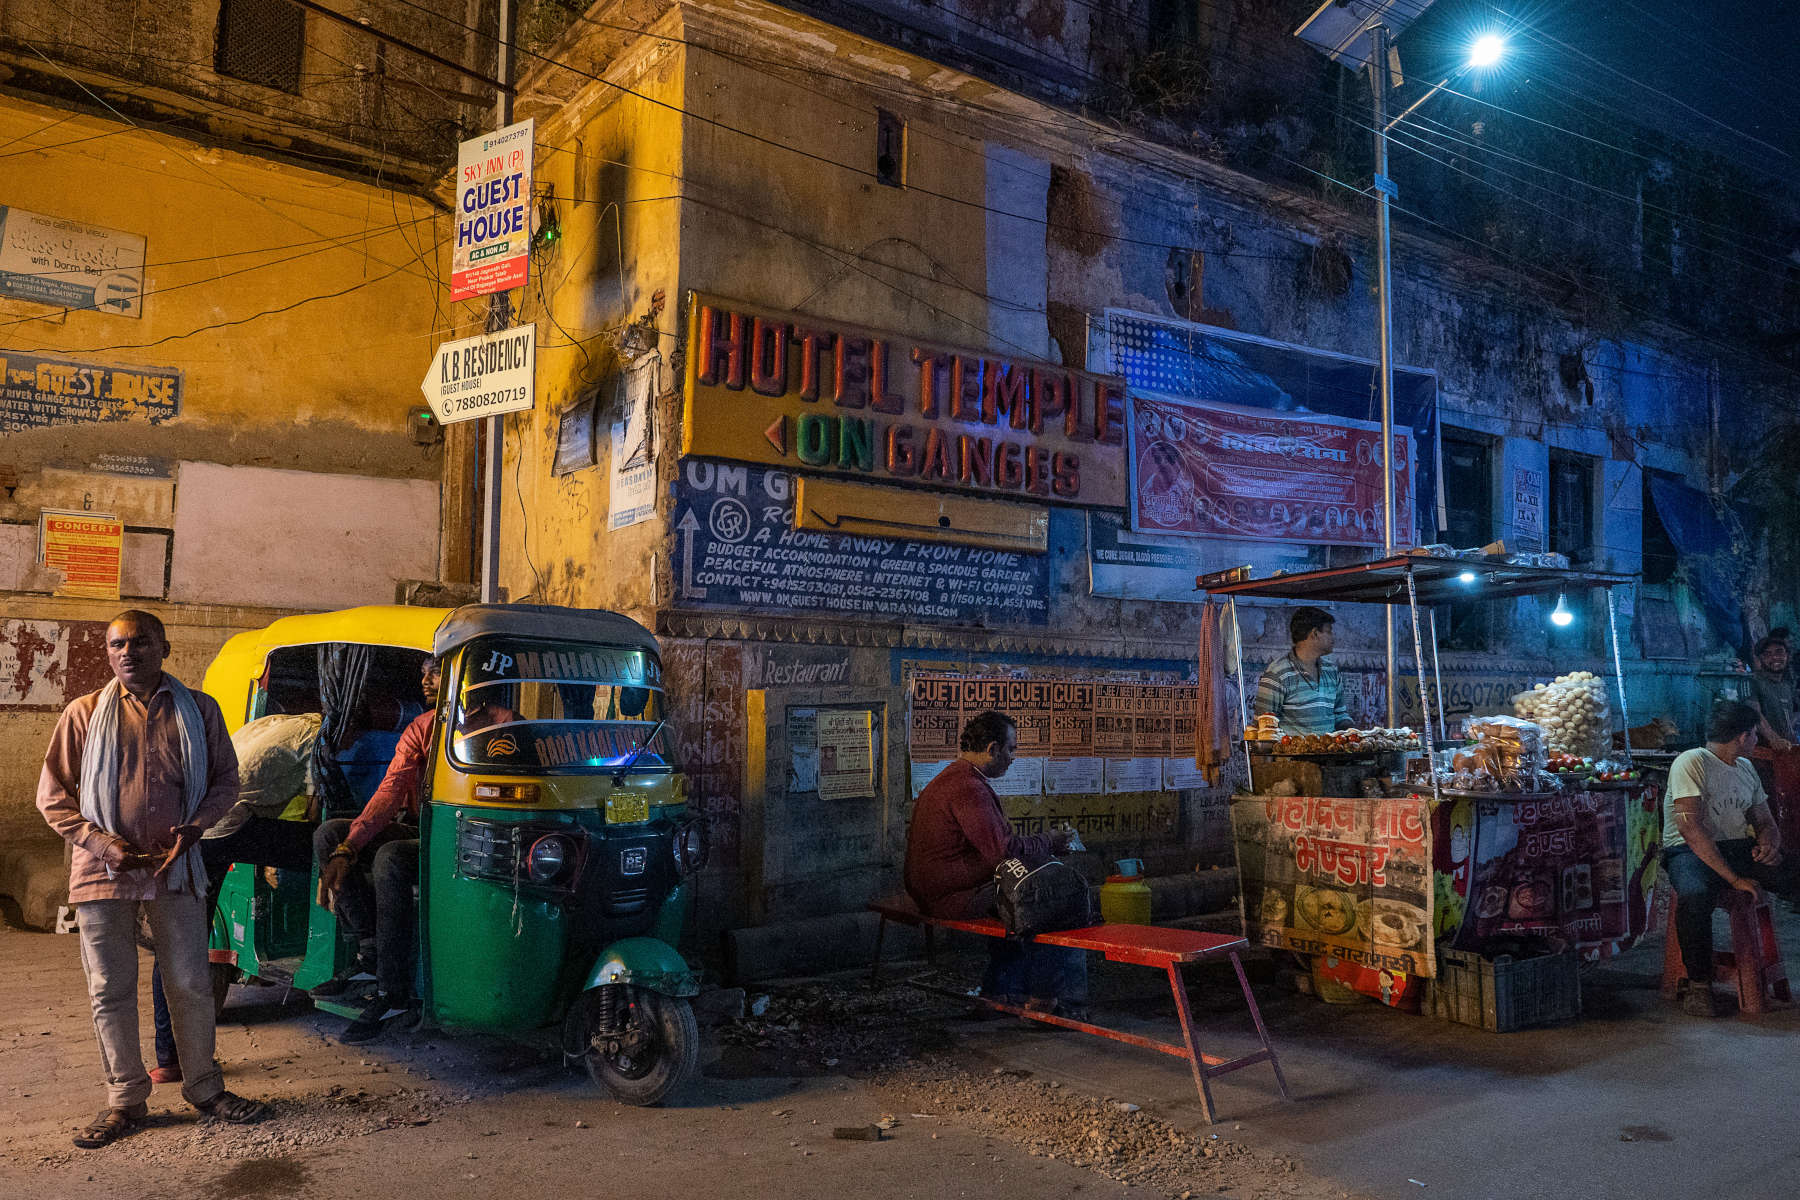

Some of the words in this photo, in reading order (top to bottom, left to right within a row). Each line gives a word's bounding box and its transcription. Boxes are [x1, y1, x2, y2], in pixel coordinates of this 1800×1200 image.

[464, 162, 483, 183] SKY
[486, 154, 504, 176] INN
[508, 148, 524, 169] (P)
[463, 172, 523, 214] GUEST
[458, 204, 524, 248] HOUSE
[31, 255, 50, 267] with
[54, 258, 81, 271] Dorm
[486, 246, 499, 256] NON
[464, 334, 529, 379] RESIDENCY
[441, 382, 460, 396] (GUEST
[461, 377, 482, 393] HOUSE)
[455, 386, 526, 412] 7880820719
[910, 346, 1126, 447] TEMPLE
[32, 403, 57, 414] WITH
[796, 413, 875, 473] ON
[884, 423, 1081, 498] GANGES
[687, 461, 747, 496] OM
[55, 521, 115, 533] CONCERT
[753, 527, 771, 543] A
[779, 530, 830, 549] HOME
[839, 537, 895, 555] AWAY
[904, 542, 961, 561] FROM
[967, 550, 1022, 567] HOME
[707, 542, 762, 558] BUDGET
[764, 549, 870, 568] ACCOMMODATION
[880, 558, 919, 572] GREEN
[928, 562, 978, 577] SPACIOUS
[981, 569, 1031, 582] GARDEN
[696, 572, 761, 588] CONTACT
[703, 556, 778, 575] PEACEFUL
[781, 563, 863, 582] ATMOSPHERE
[873, 571, 932, 588] INTERNET
[949, 577, 981, 592] WI-FI
[983, 583, 1034, 596] CAMPUS
[482, 651, 513, 676] JP
[765, 657, 849, 684] Restaurant
[914, 680, 959, 702] CUET
[964, 682, 1006, 702] CUET
[1009, 683, 1051, 702] CUET
[1053, 684, 1092, 703] CUET
[912, 715, 938, 729] CHS
[1053, 717, 1075, 729] CHS
[1296, 835, 1389, 887] भण्डार
